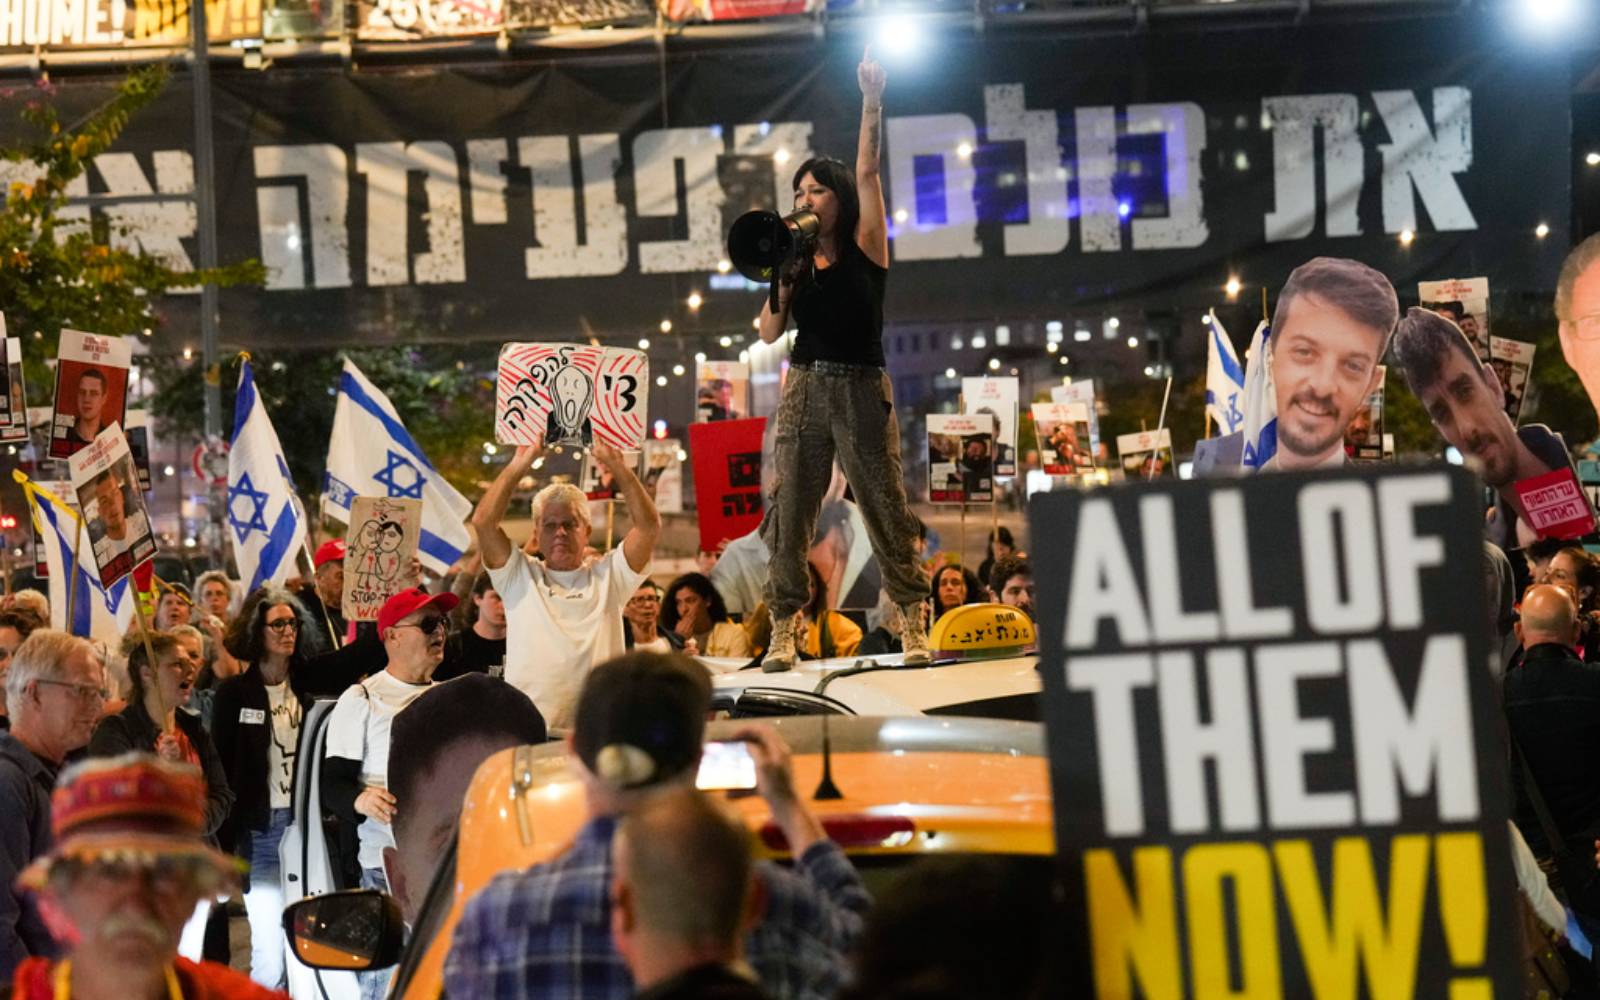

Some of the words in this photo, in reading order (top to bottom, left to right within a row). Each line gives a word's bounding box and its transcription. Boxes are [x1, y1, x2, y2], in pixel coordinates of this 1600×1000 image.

[0, 0, 126, 46] HOME!
[887, 83, 1209, 256] כולם
[1262, 86, 1478, 242] את
[1063, 488, 1294, 649] ALL
[1298, 473, 1452, 635] OF
[1536, 502, 1579, 526] האחרון
[1558, 482, 1574, 496] עד
[351, 590, 376, 604] STOP
[1065, 634, 1482, 838] THEM
[1083, 832, 1492, 1000] NOW!
